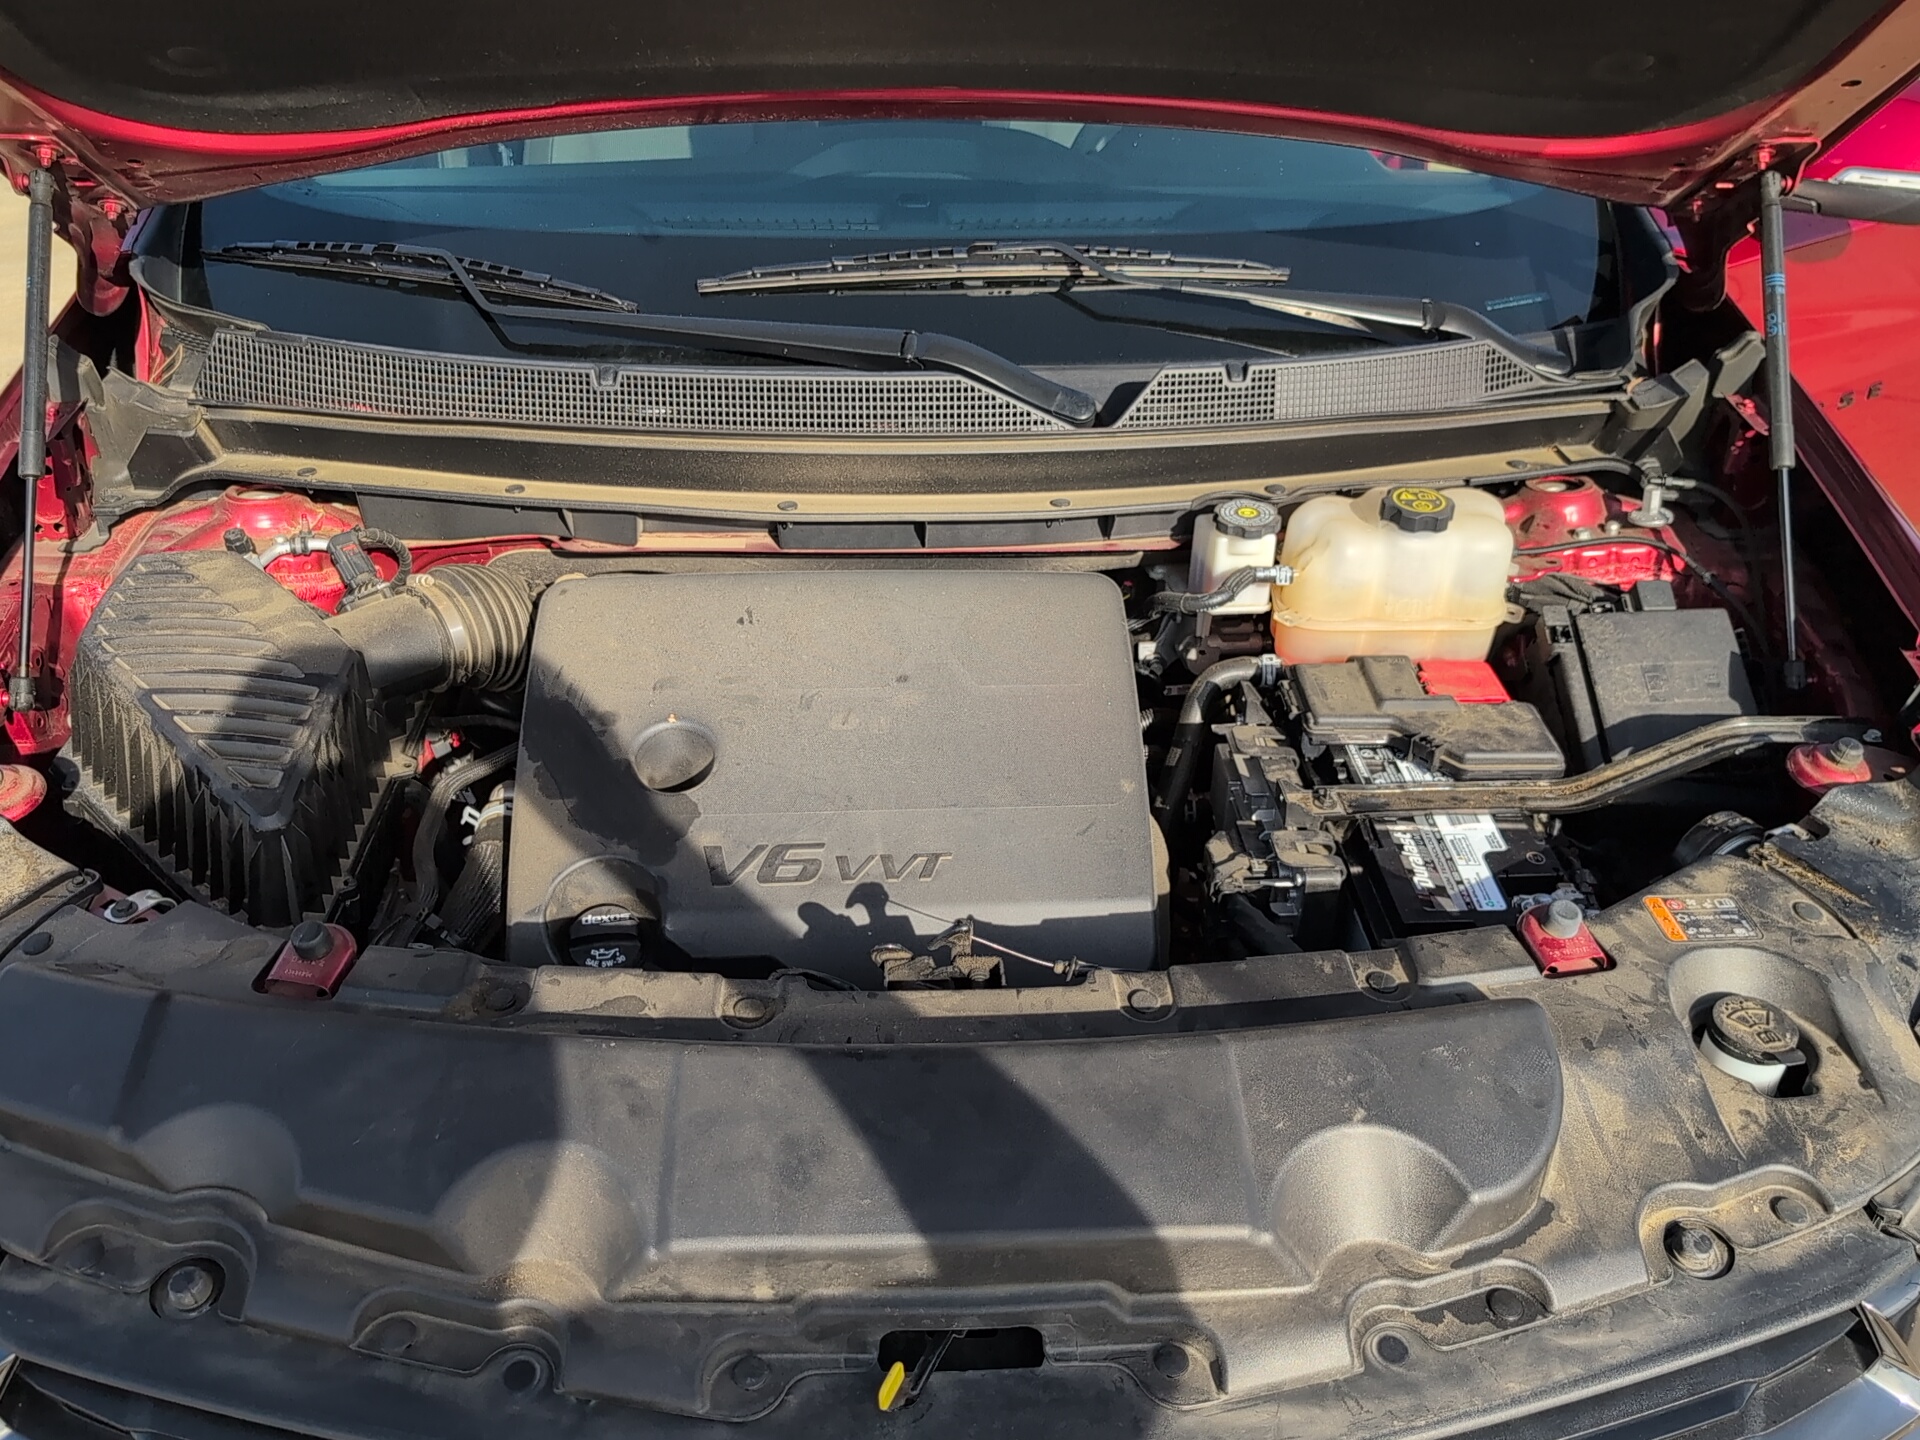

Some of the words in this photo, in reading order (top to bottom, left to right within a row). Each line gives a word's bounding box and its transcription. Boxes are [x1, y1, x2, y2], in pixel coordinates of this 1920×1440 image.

[703, 842, 826, 886] V6
[835, 852, 953, 882] VVT
[1392, 831, 1435, 889] Duralast
[1423, 831, 1447, 873] TECHNOLOGY
[581, 913, 631, 925] dexos
[585, 958, 600, 968] SAE
[601, 955, 626, 968] 5W-30
